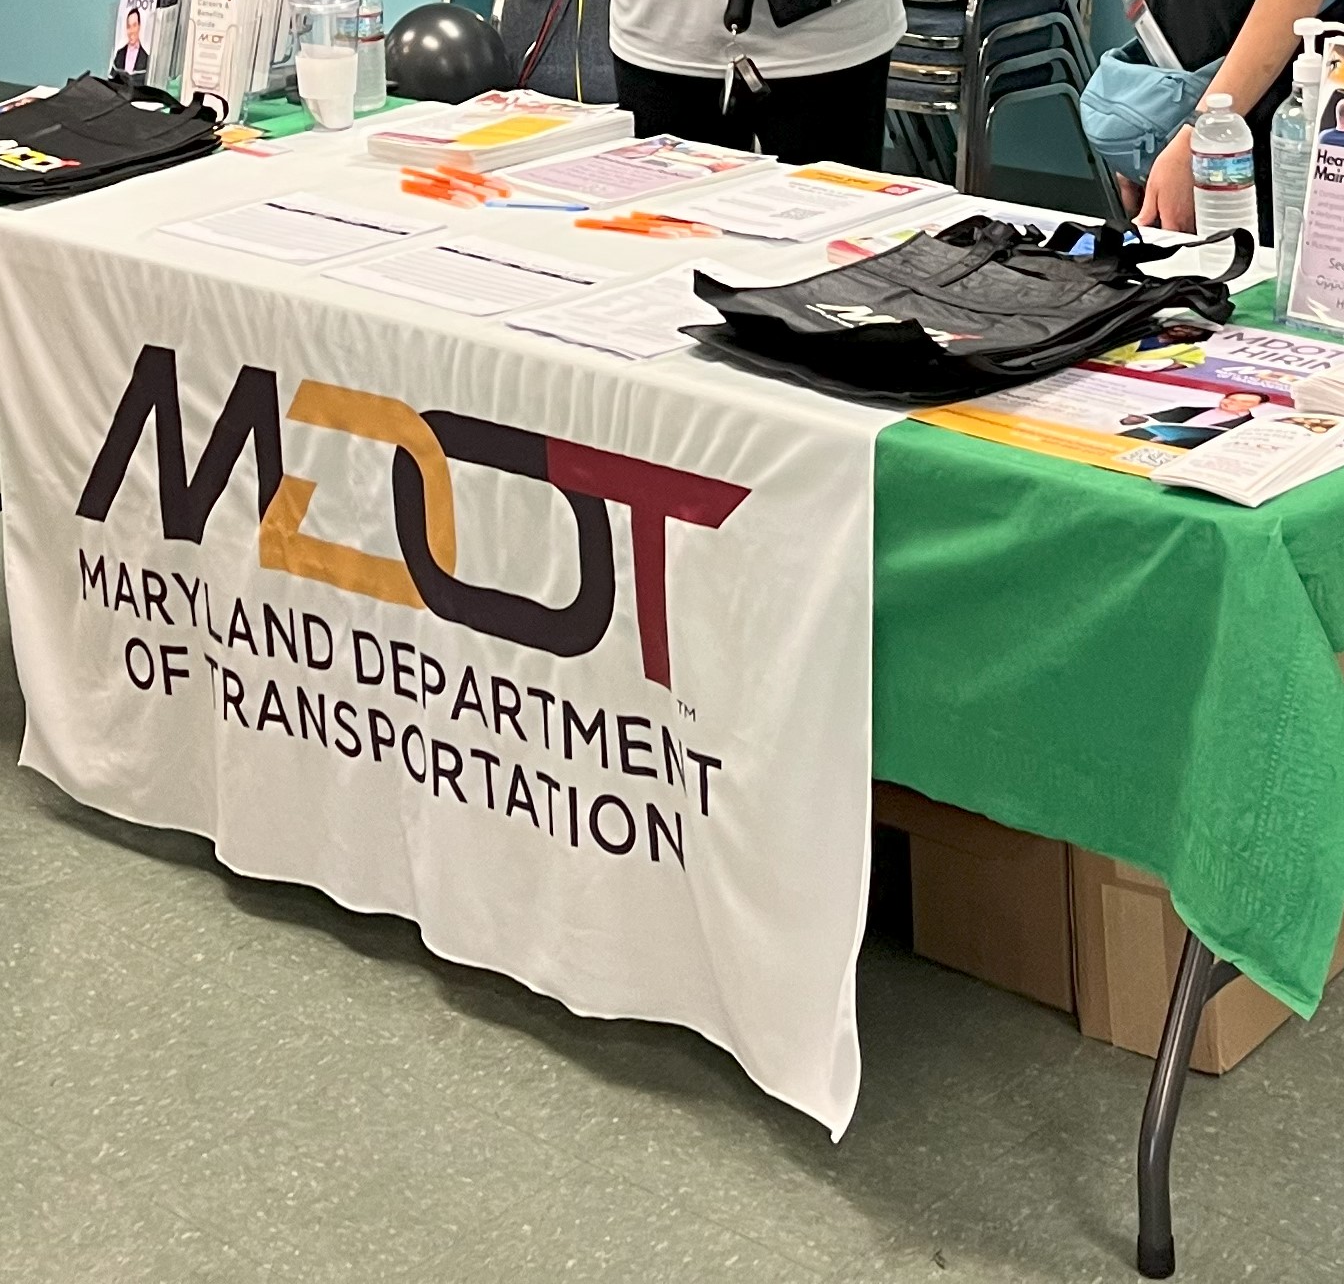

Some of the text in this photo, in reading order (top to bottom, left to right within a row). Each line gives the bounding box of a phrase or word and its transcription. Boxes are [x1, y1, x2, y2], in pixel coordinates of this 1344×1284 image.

[1228, 347, 1332, 370] HIRIN
[74, 344, 753, 690] MDOT
[78, 549, 723, 818] MARYLAND DEPARTMENT
[125, 638, 686, 871] OF TRANSPORTATION
